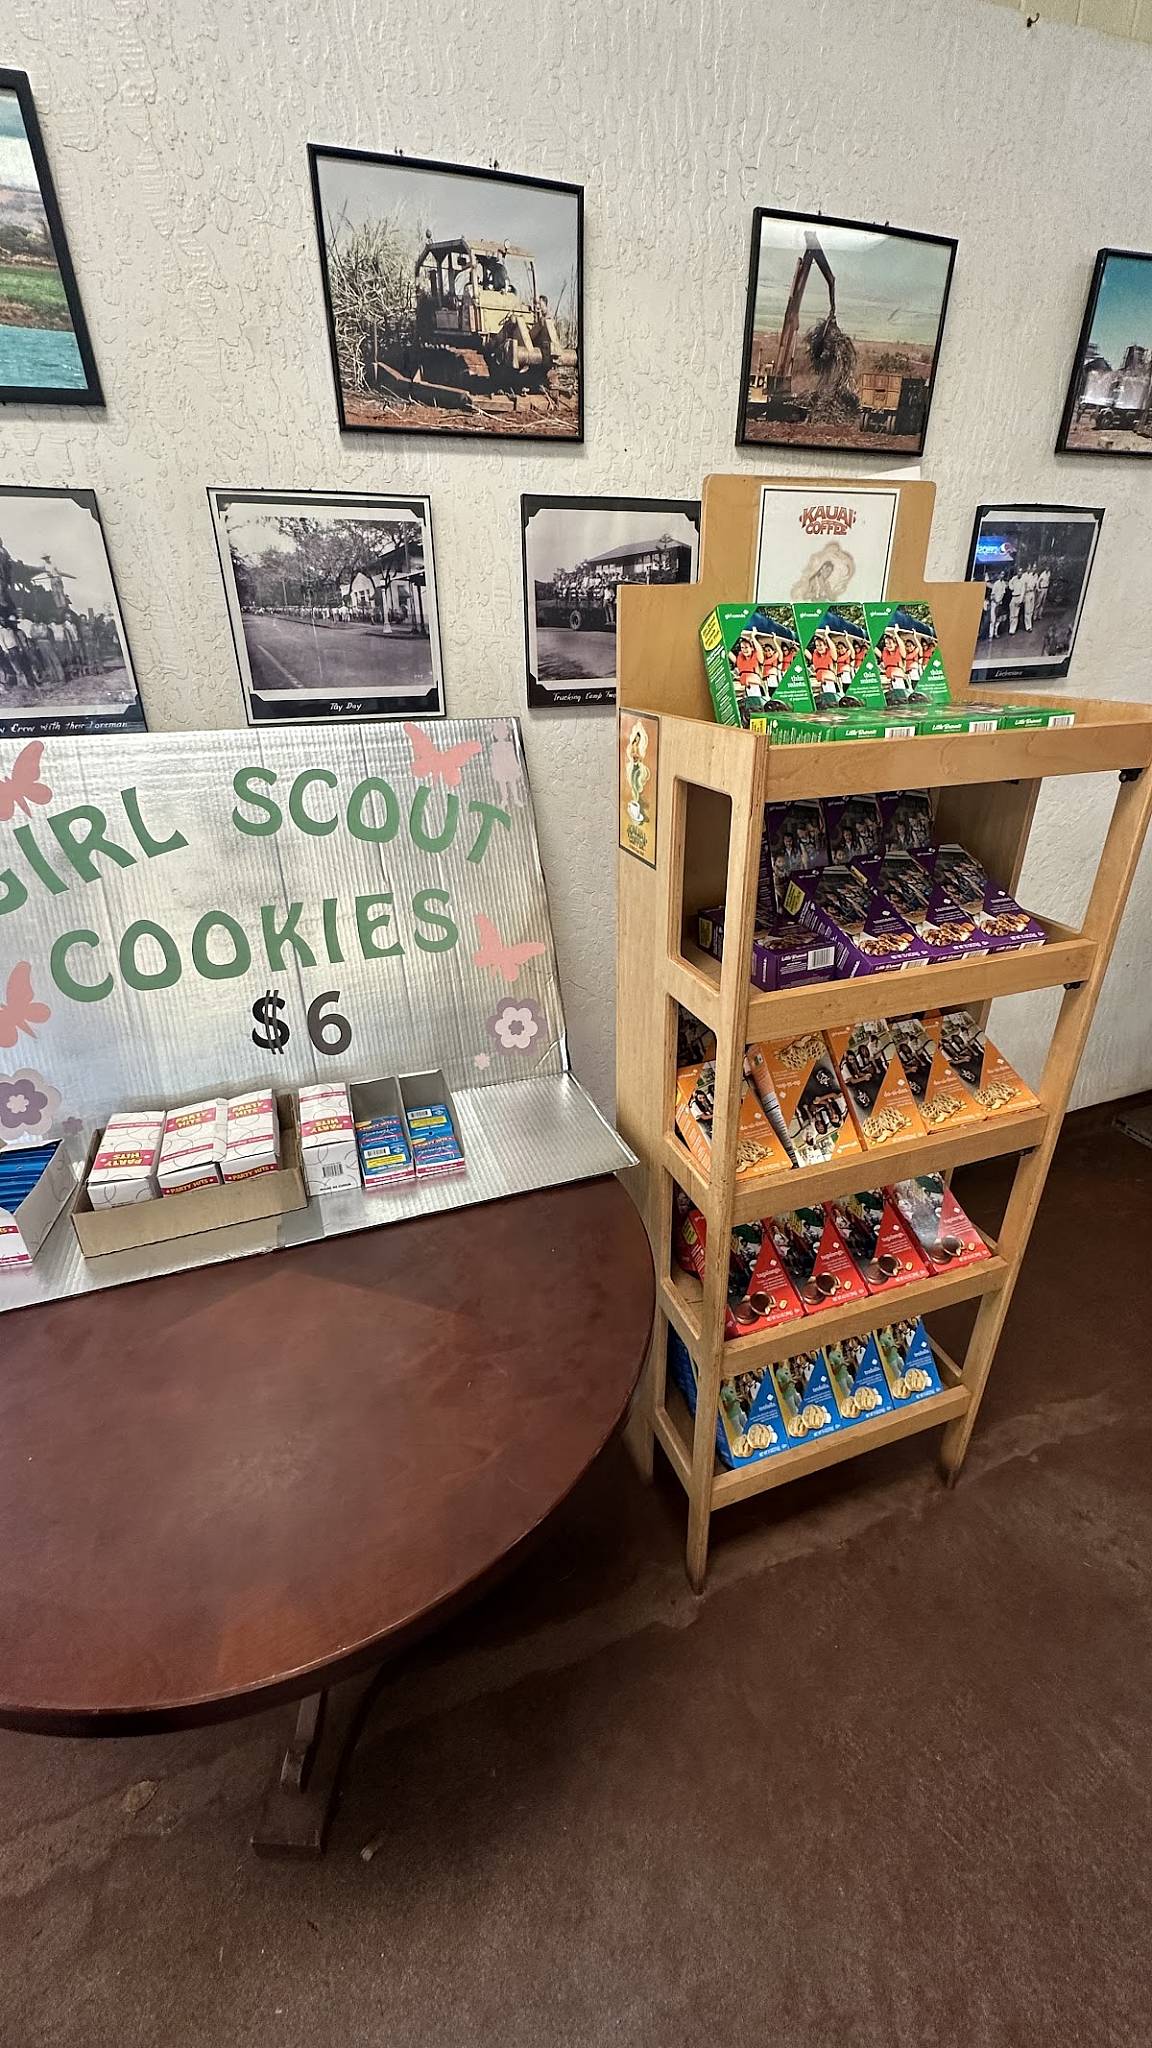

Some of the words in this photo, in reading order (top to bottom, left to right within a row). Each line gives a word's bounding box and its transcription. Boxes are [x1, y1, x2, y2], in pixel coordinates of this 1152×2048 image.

[802, 505, 855, 528] KAUAI
[805, 520, 848, 535] COFFEE
[346, 702, 362, 711] Day
[11, 723, 34, 733] Crew
[40, 721, 61, 731] with
[232, 766, 512, 865] SCOUT
[50, 888, 460, 1003] COOKIES
[231, 1099, 264, 1113] PARTY
[234, 1107, 259, 1119] HITS
[112, 1151, 141, 1160] HITS
